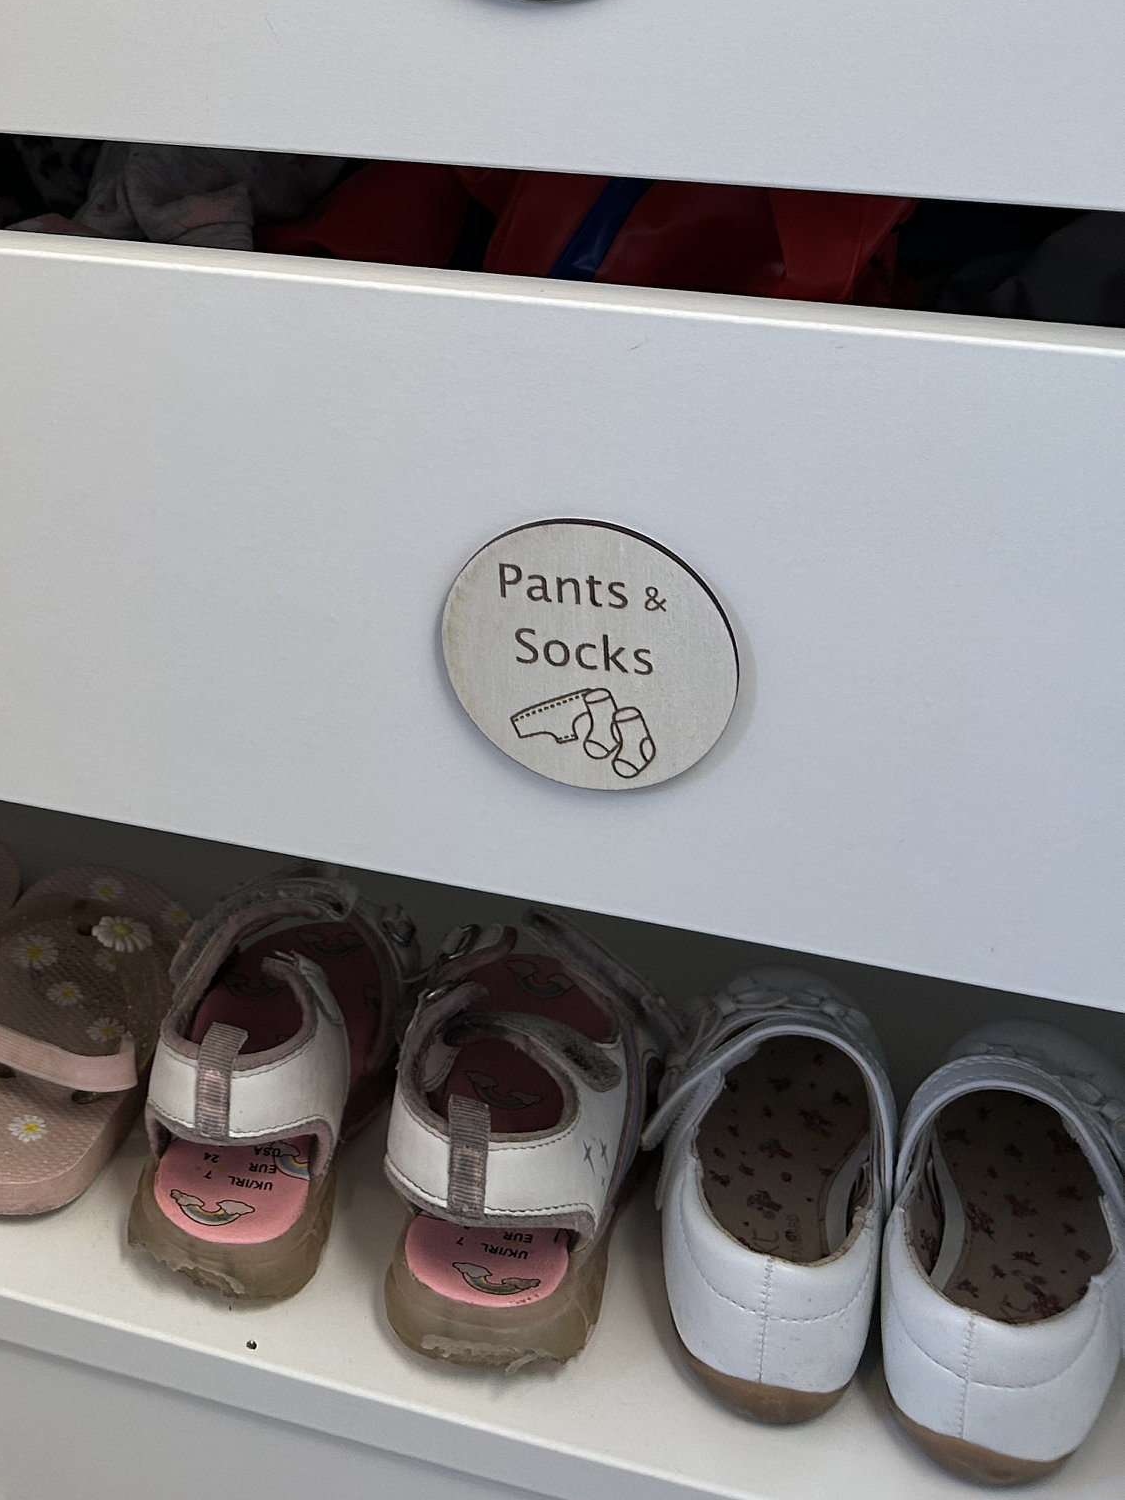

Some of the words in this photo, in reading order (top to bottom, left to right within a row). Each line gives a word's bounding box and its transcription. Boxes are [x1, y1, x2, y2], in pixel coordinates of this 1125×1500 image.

[498, 563, 628, 610] Pants
[644, 586, 667, 612] &
[515, 628, 654, 676] Socks
[203, 1152, 220, 1164] 24
[203, 1170, 212, 1180] 7
[248, 1162, 278, 1175] EUR
[228, 1175, 274, 1191] UK/IRL
[455, 1236, 465, 1246] 7
[502, 1231, 534, 1244] EUR
[480, 1242, 529, 1260] UK/IRL
